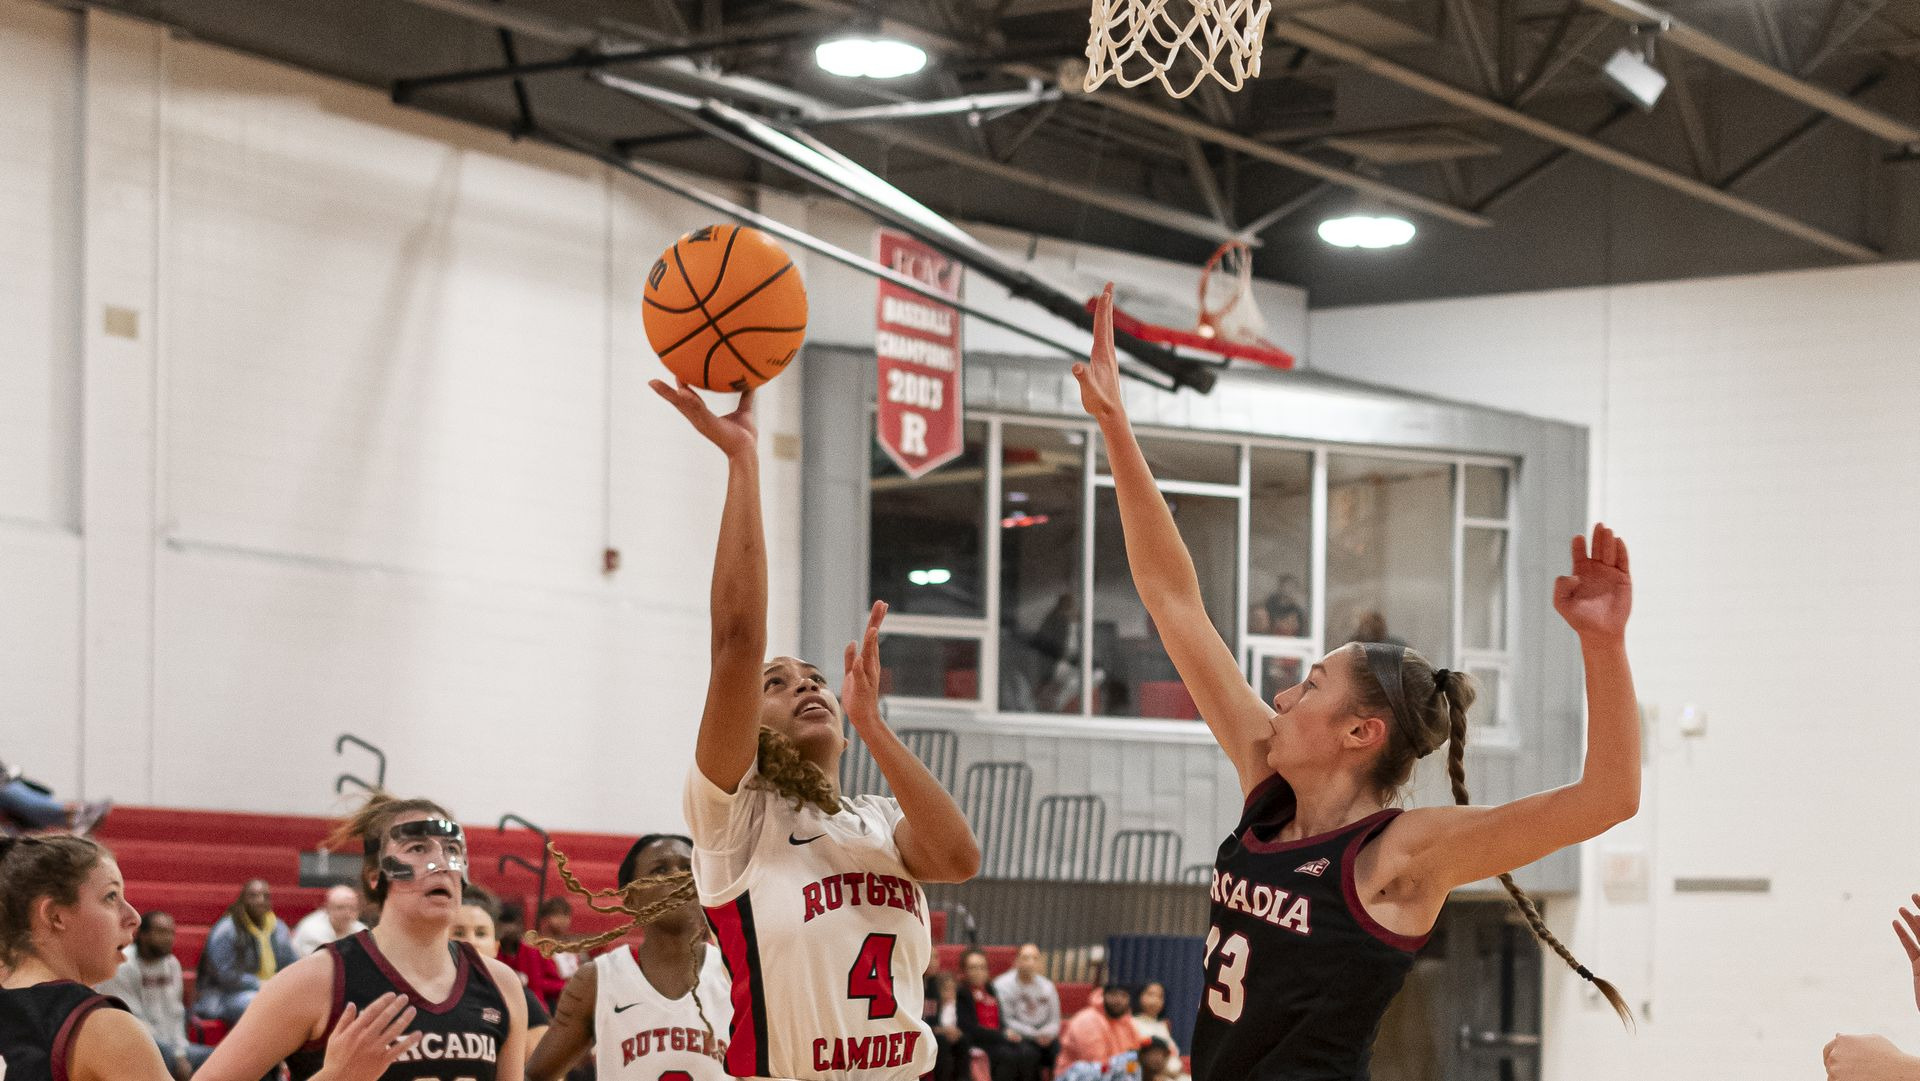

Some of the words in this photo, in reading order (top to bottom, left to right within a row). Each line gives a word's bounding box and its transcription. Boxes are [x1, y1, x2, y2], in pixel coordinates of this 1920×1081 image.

[883, 296, 951, 336] BASEBALL
[887, 367, 943, 411] 2003
[900, 411, 928, 457] R
[1209, 867, 1312, 935] RCADIA
[847, 932, 898, 1020] 4
[390, 1032, 497, 1063] RCADIA
[812, 1031, 922, 1072] CAMDEN
